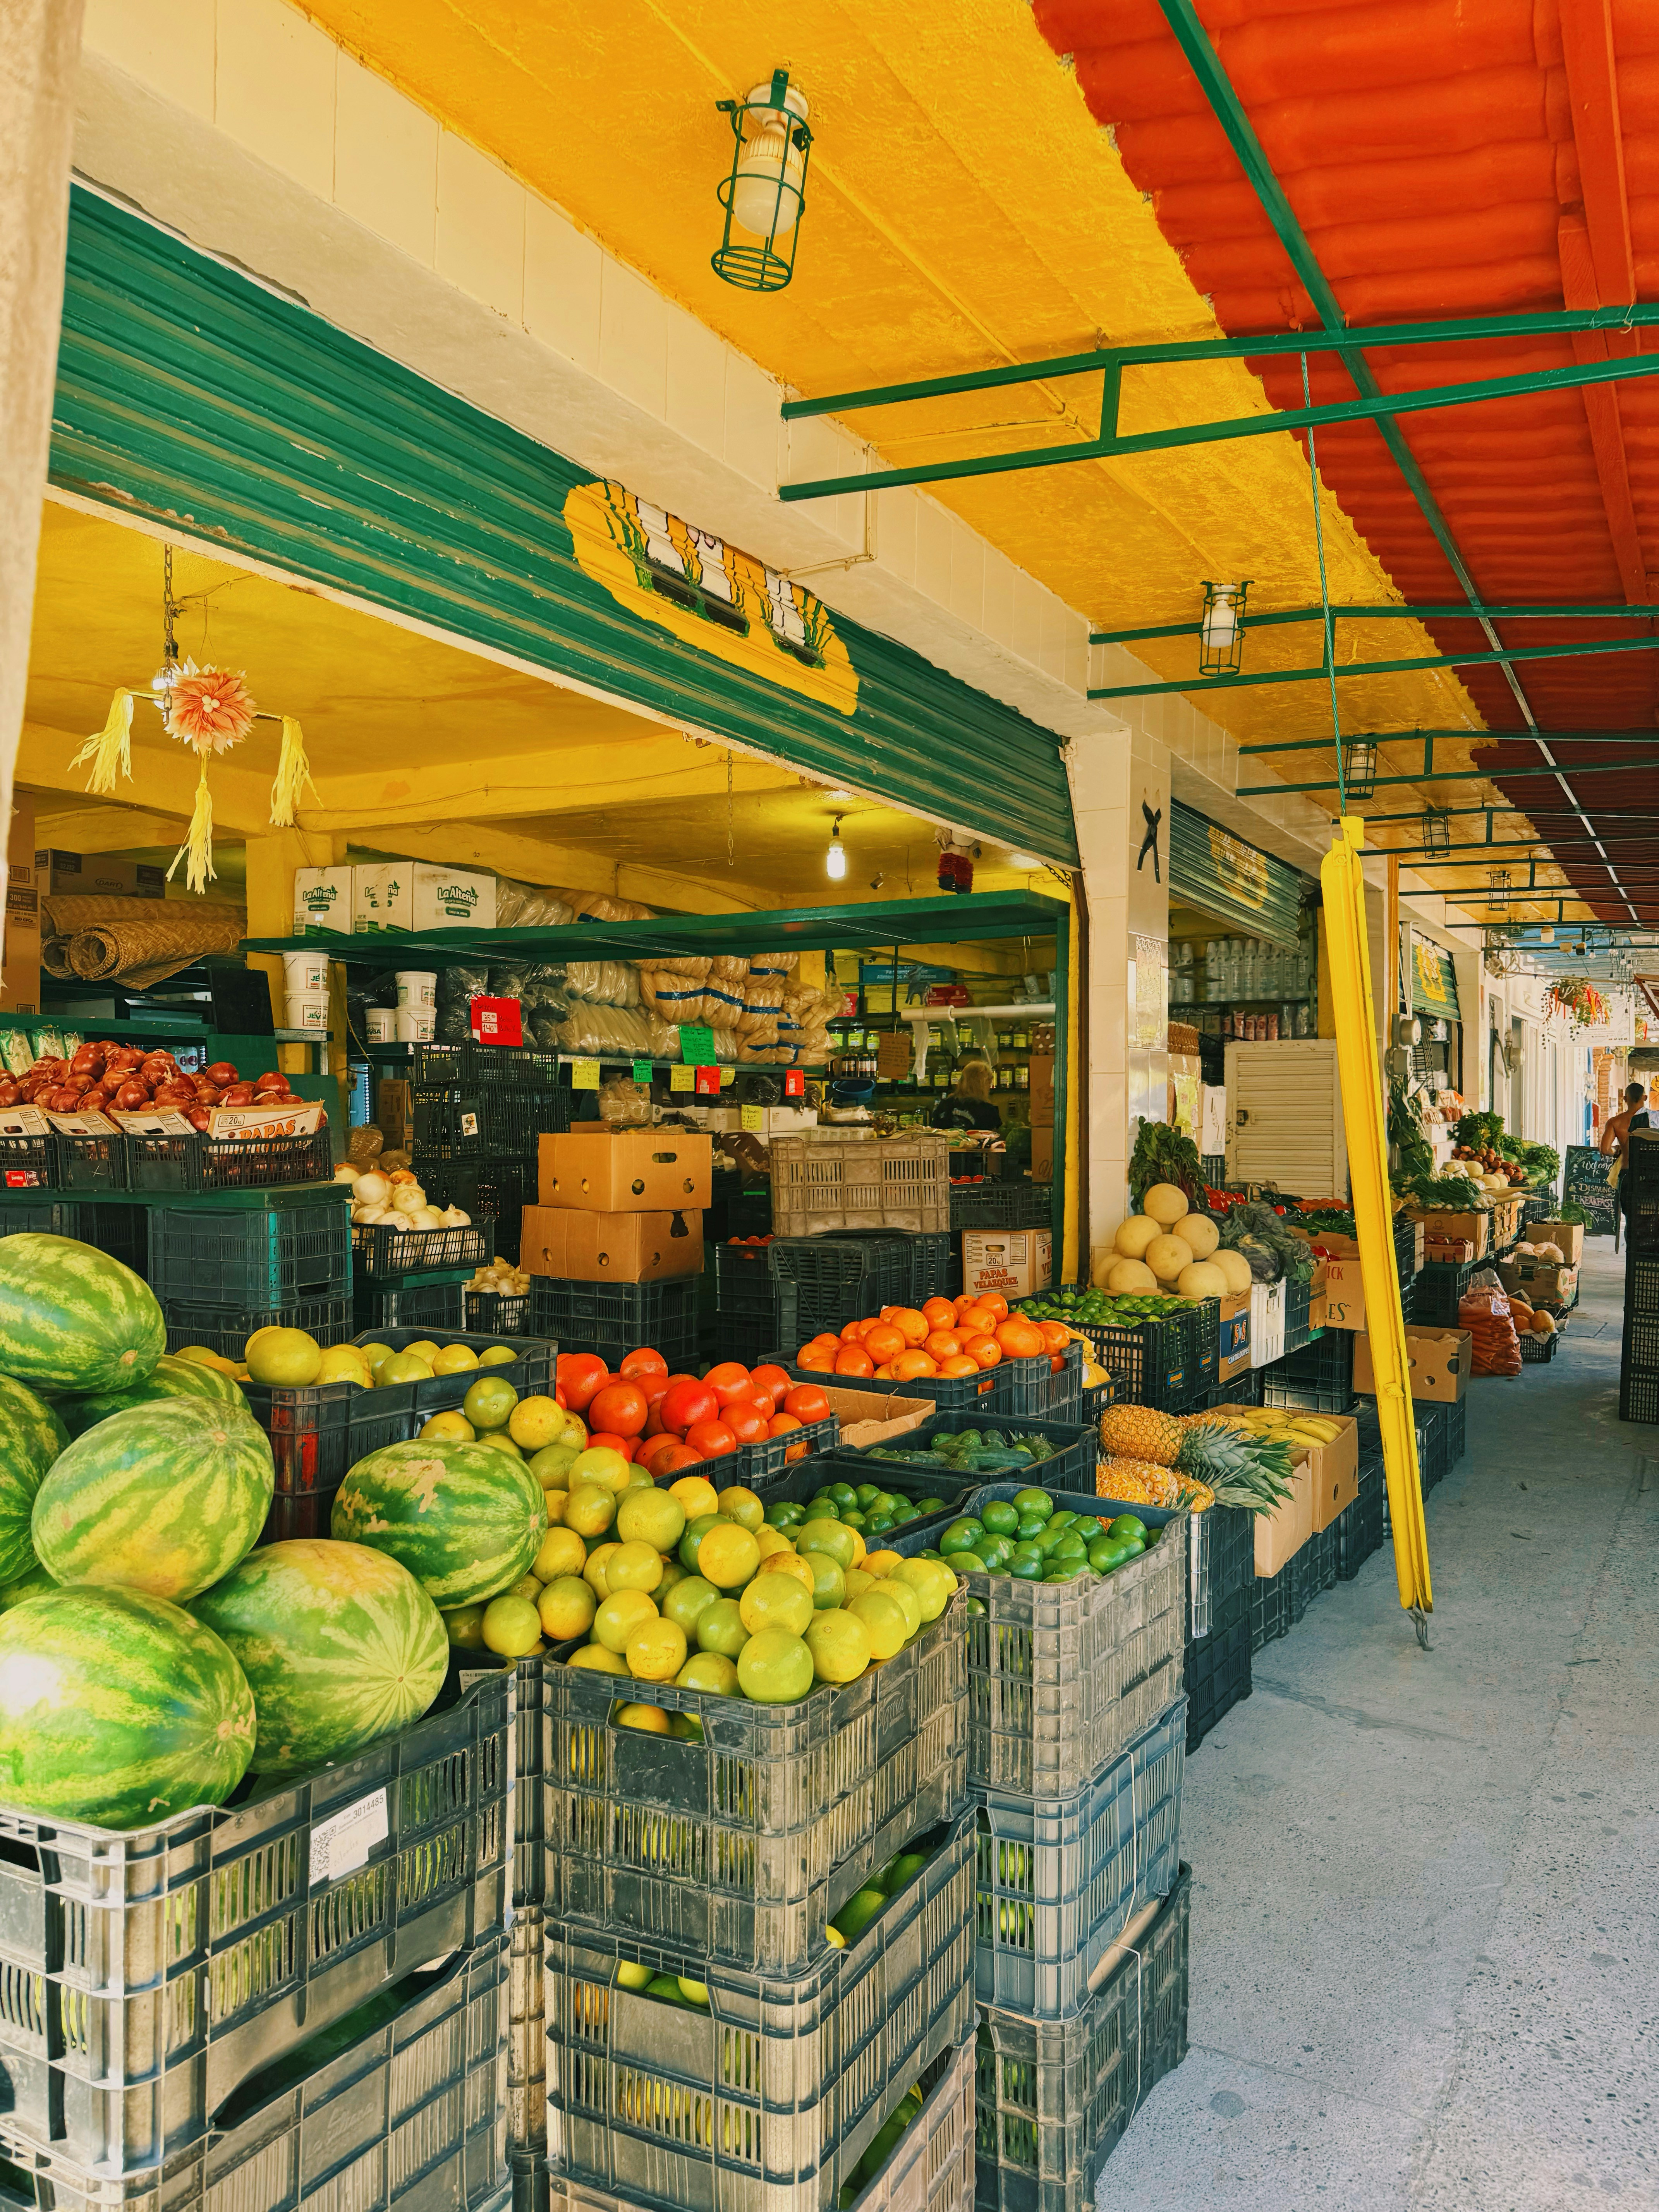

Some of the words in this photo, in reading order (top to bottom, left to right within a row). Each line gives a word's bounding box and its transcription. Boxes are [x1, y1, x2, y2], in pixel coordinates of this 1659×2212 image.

[99, 879, 120, 888] DART
[438, 887, 449, 900] La
[450, 886, 477, 906] Alteña
[239, 1120, 296, 1139] PAPAS
[979, 1268, 1008, 1280] PAPAS
[974, 1276, 1018, 1289] VELAZQUEZ
[353, 1794, 384, 1819] 3014485
